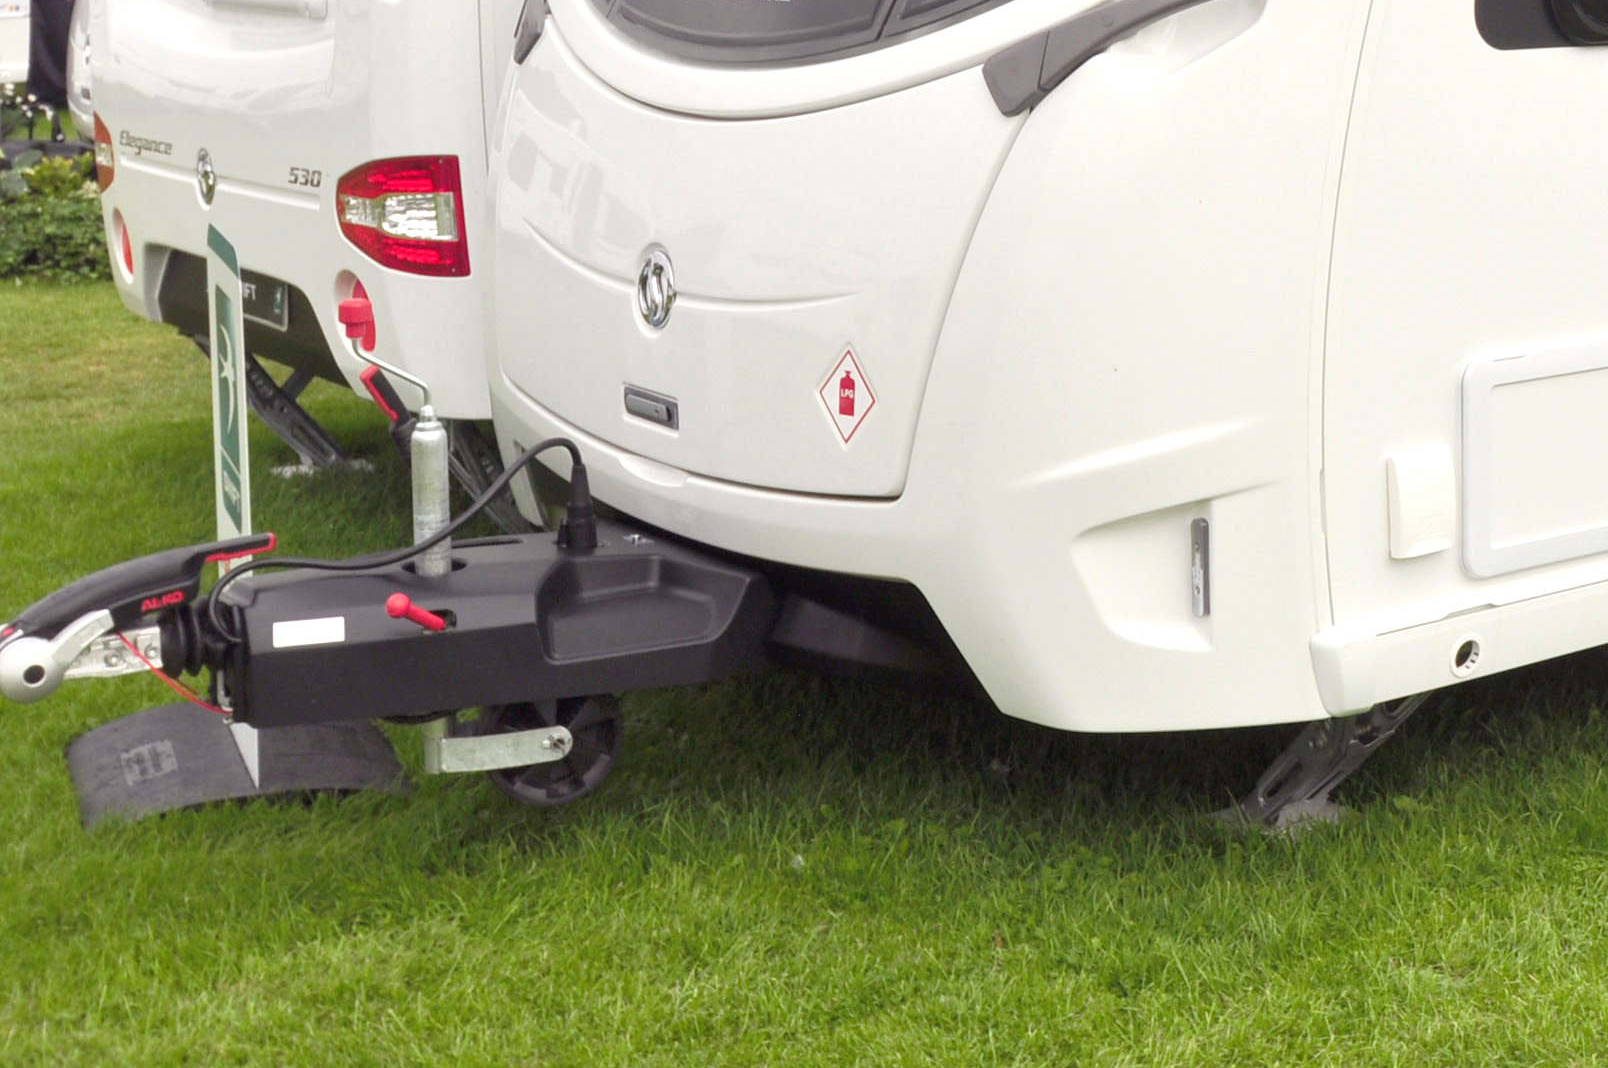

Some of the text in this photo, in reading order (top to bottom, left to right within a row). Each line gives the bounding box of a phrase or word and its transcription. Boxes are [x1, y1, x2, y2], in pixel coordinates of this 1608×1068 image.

[119, 130, 173, 156] Elegance
[288, 167, 323, 188] 530
[840, 388, 854, 399] LPG
